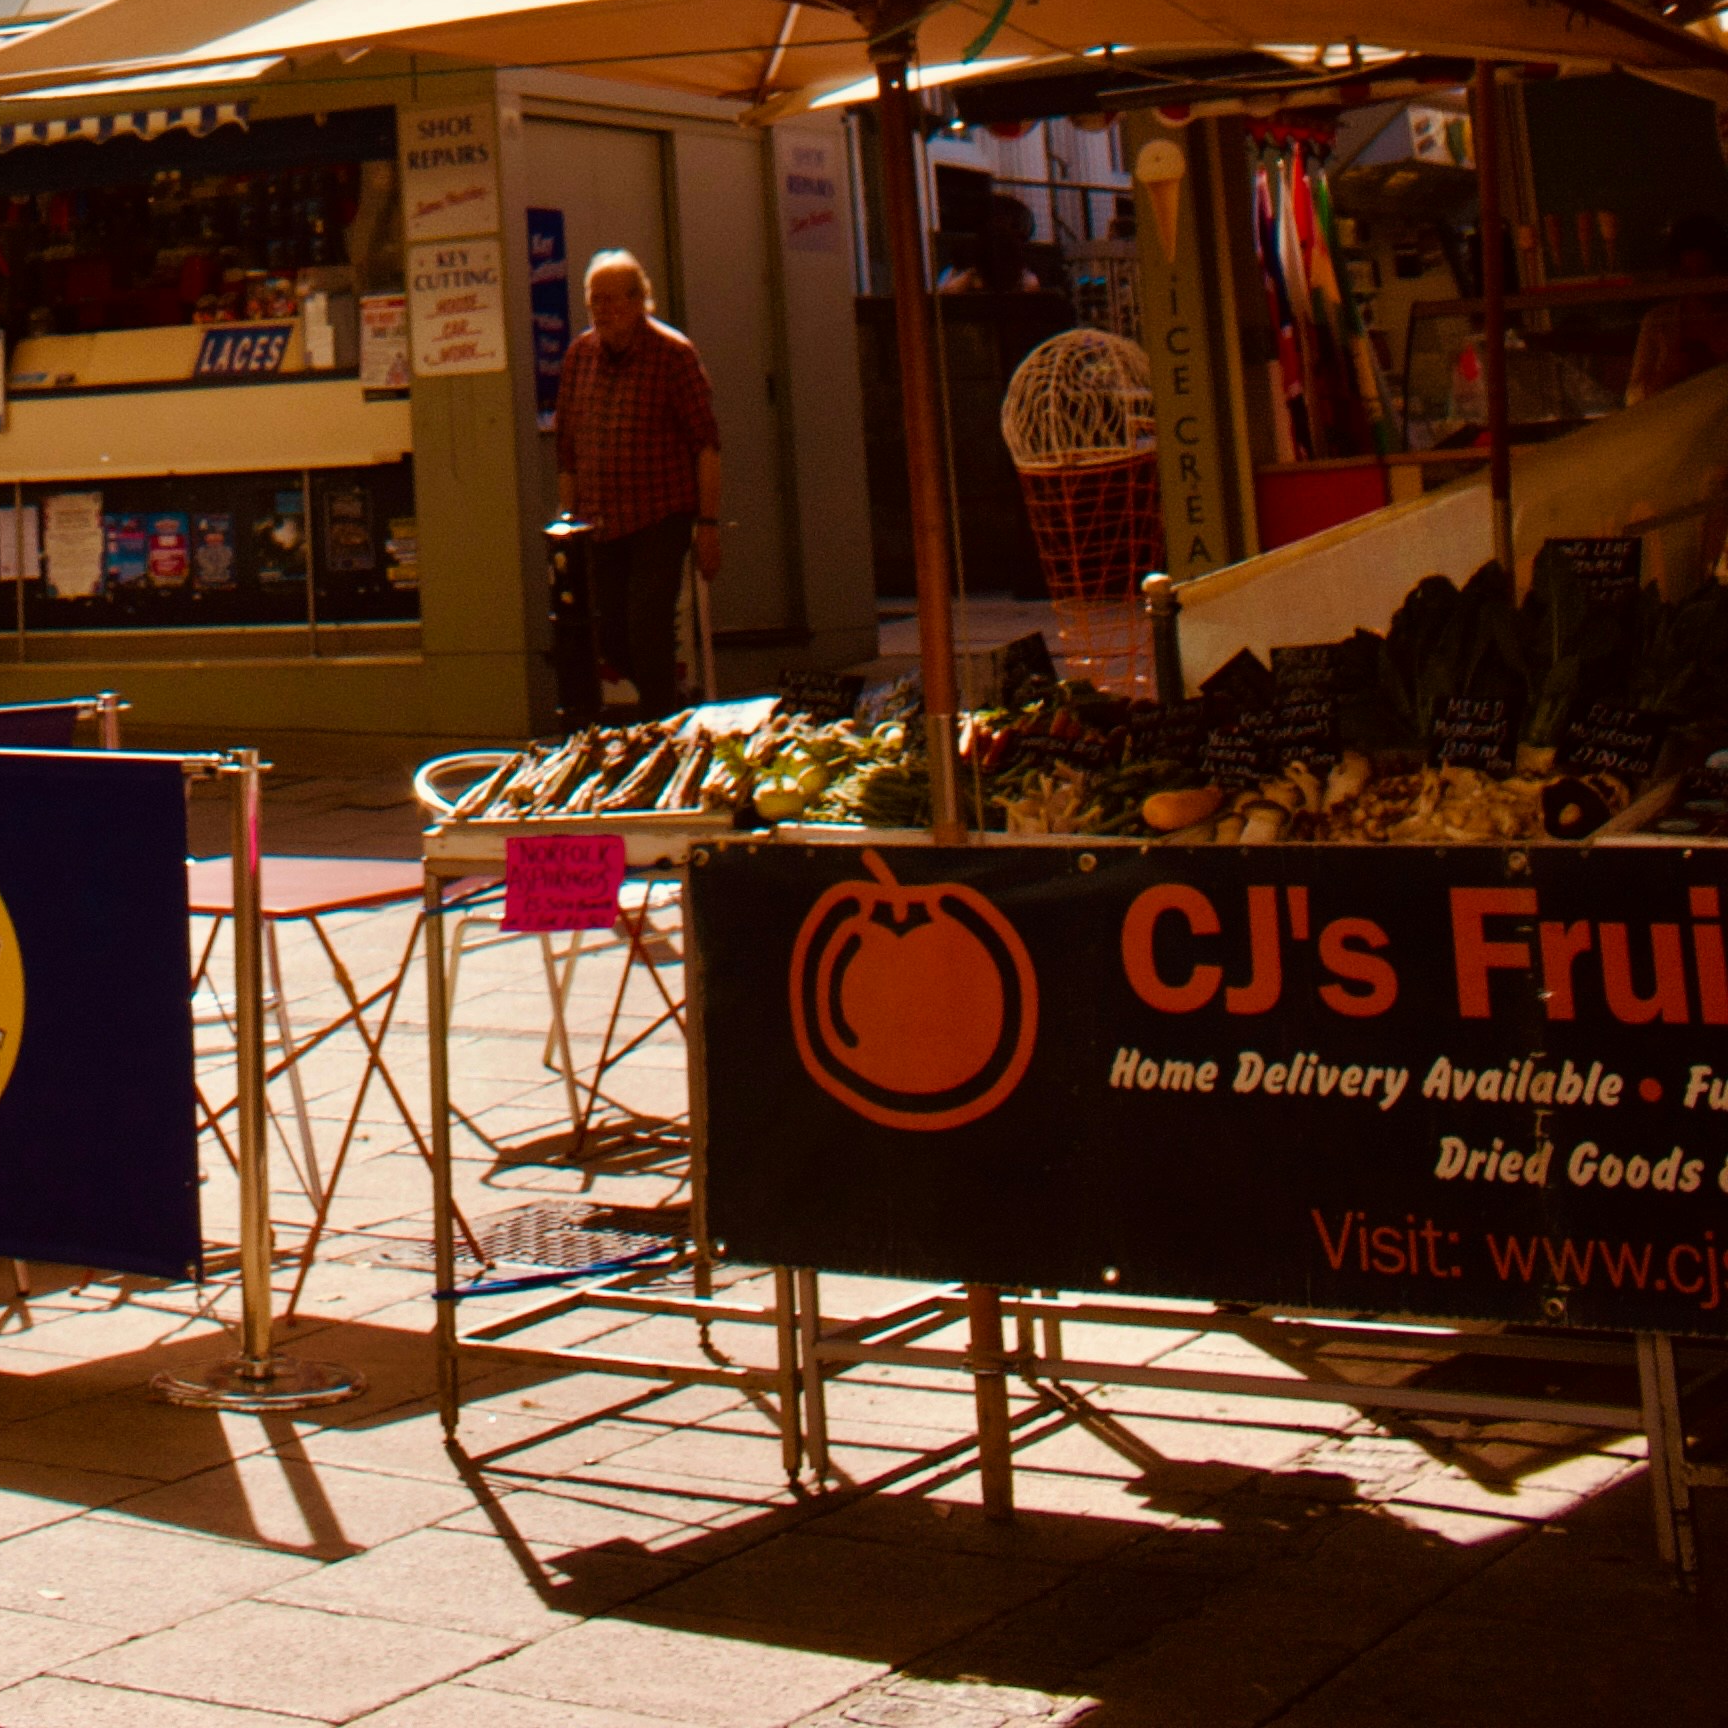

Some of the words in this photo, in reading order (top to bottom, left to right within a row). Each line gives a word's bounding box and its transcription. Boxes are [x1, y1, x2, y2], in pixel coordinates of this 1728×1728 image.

[416, 114, 474, 139] SHOE
[406, 144, 490, 171] REPAIRS
[435, 247, 470, 268] KEY
[414, 268, 498, 292] CUTTING
[199, 335, 286, 373] LACES
[1174, 415, 1213, 566] CREA
[1446, 697, 1505, 721] MIXED
[1588, 703, 1637, 728] FLAT
[1121, 883, 1399, 1018] CJ's
[1449, 885, 1728, 1024] Frui
[1110, 1046, 1219, 1093] Home
[1232, 1050, 1410, 1111] Delivery
[1422, 1054, 1624, 1107] Available
[1683, 1065, 1728, 1111] Fu
[1434, 1135, 1554, 1185] Dried
[1567, 1140, 1705, 1193] Goods
[1311, 1209, 1464, 1278] Visit:
